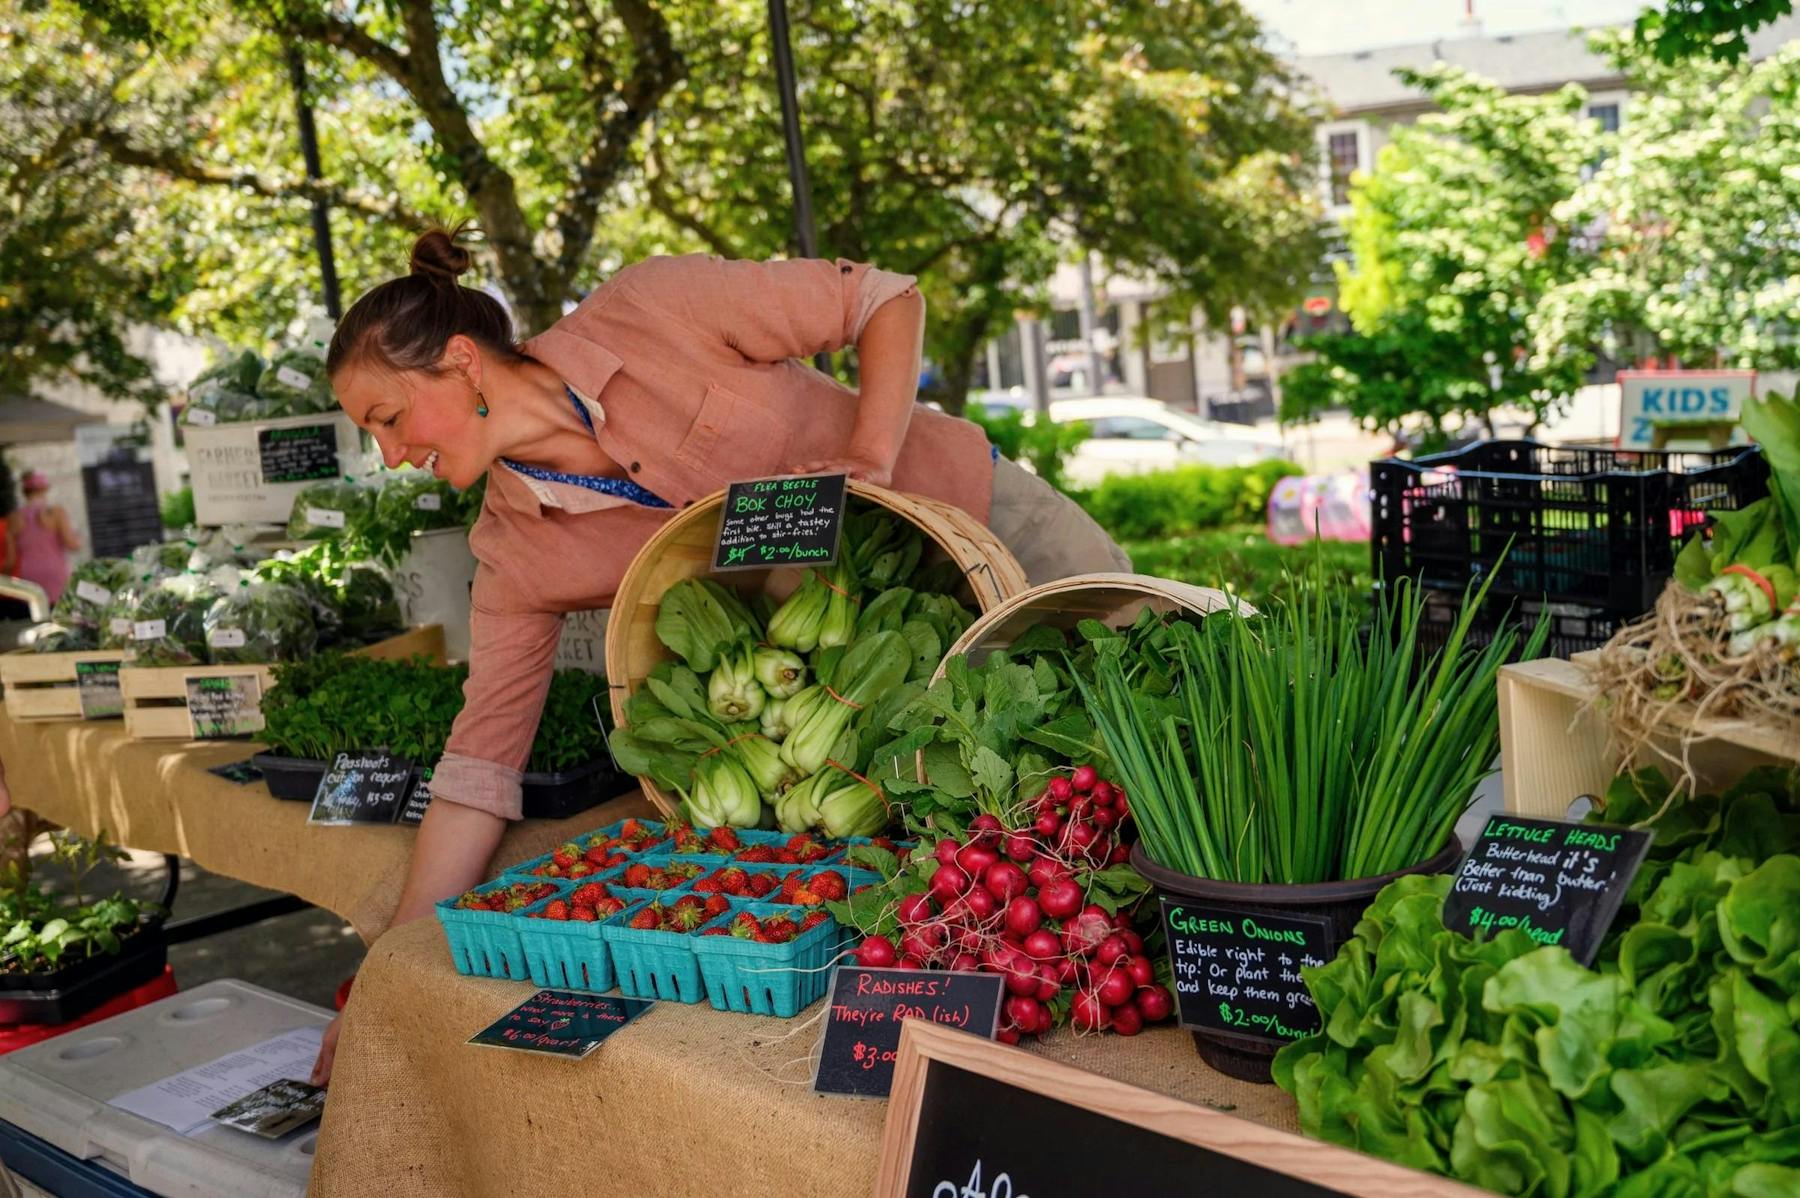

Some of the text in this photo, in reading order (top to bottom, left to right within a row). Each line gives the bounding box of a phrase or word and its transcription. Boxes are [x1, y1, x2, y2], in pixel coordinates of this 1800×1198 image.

[1642, 387, 1730, 412] KIDS
[783, 480, 819, 490] BEETLE
[736, 492, 817, 512] BOK CHOY
[721, 535, 755, 546] addition
[1484, 820, 1622, 852] LETTUCE HEADS
[1486, 842, 1600, 874] Butterhead it's
[1462, 859, 1507, 878] Better
[1510, 866, 1545, 884] than
[1498, 883, 1562, 911] kidding)
[1170, 907, 1306, 946] GREEN ONIONS
[1175, 939, 1325, 968] Edible right to the
[1175, 958, 1303, 984] tip! Or plant the
[857, 973, 951, 996] RADISHES!
[1176, 980, 1199, 993] and
[1208, 979, 1238, 1000] keep
[1244, 987, 1280, 1002] them
[832, 1003, 970, 1027] They're RAD (ish)
